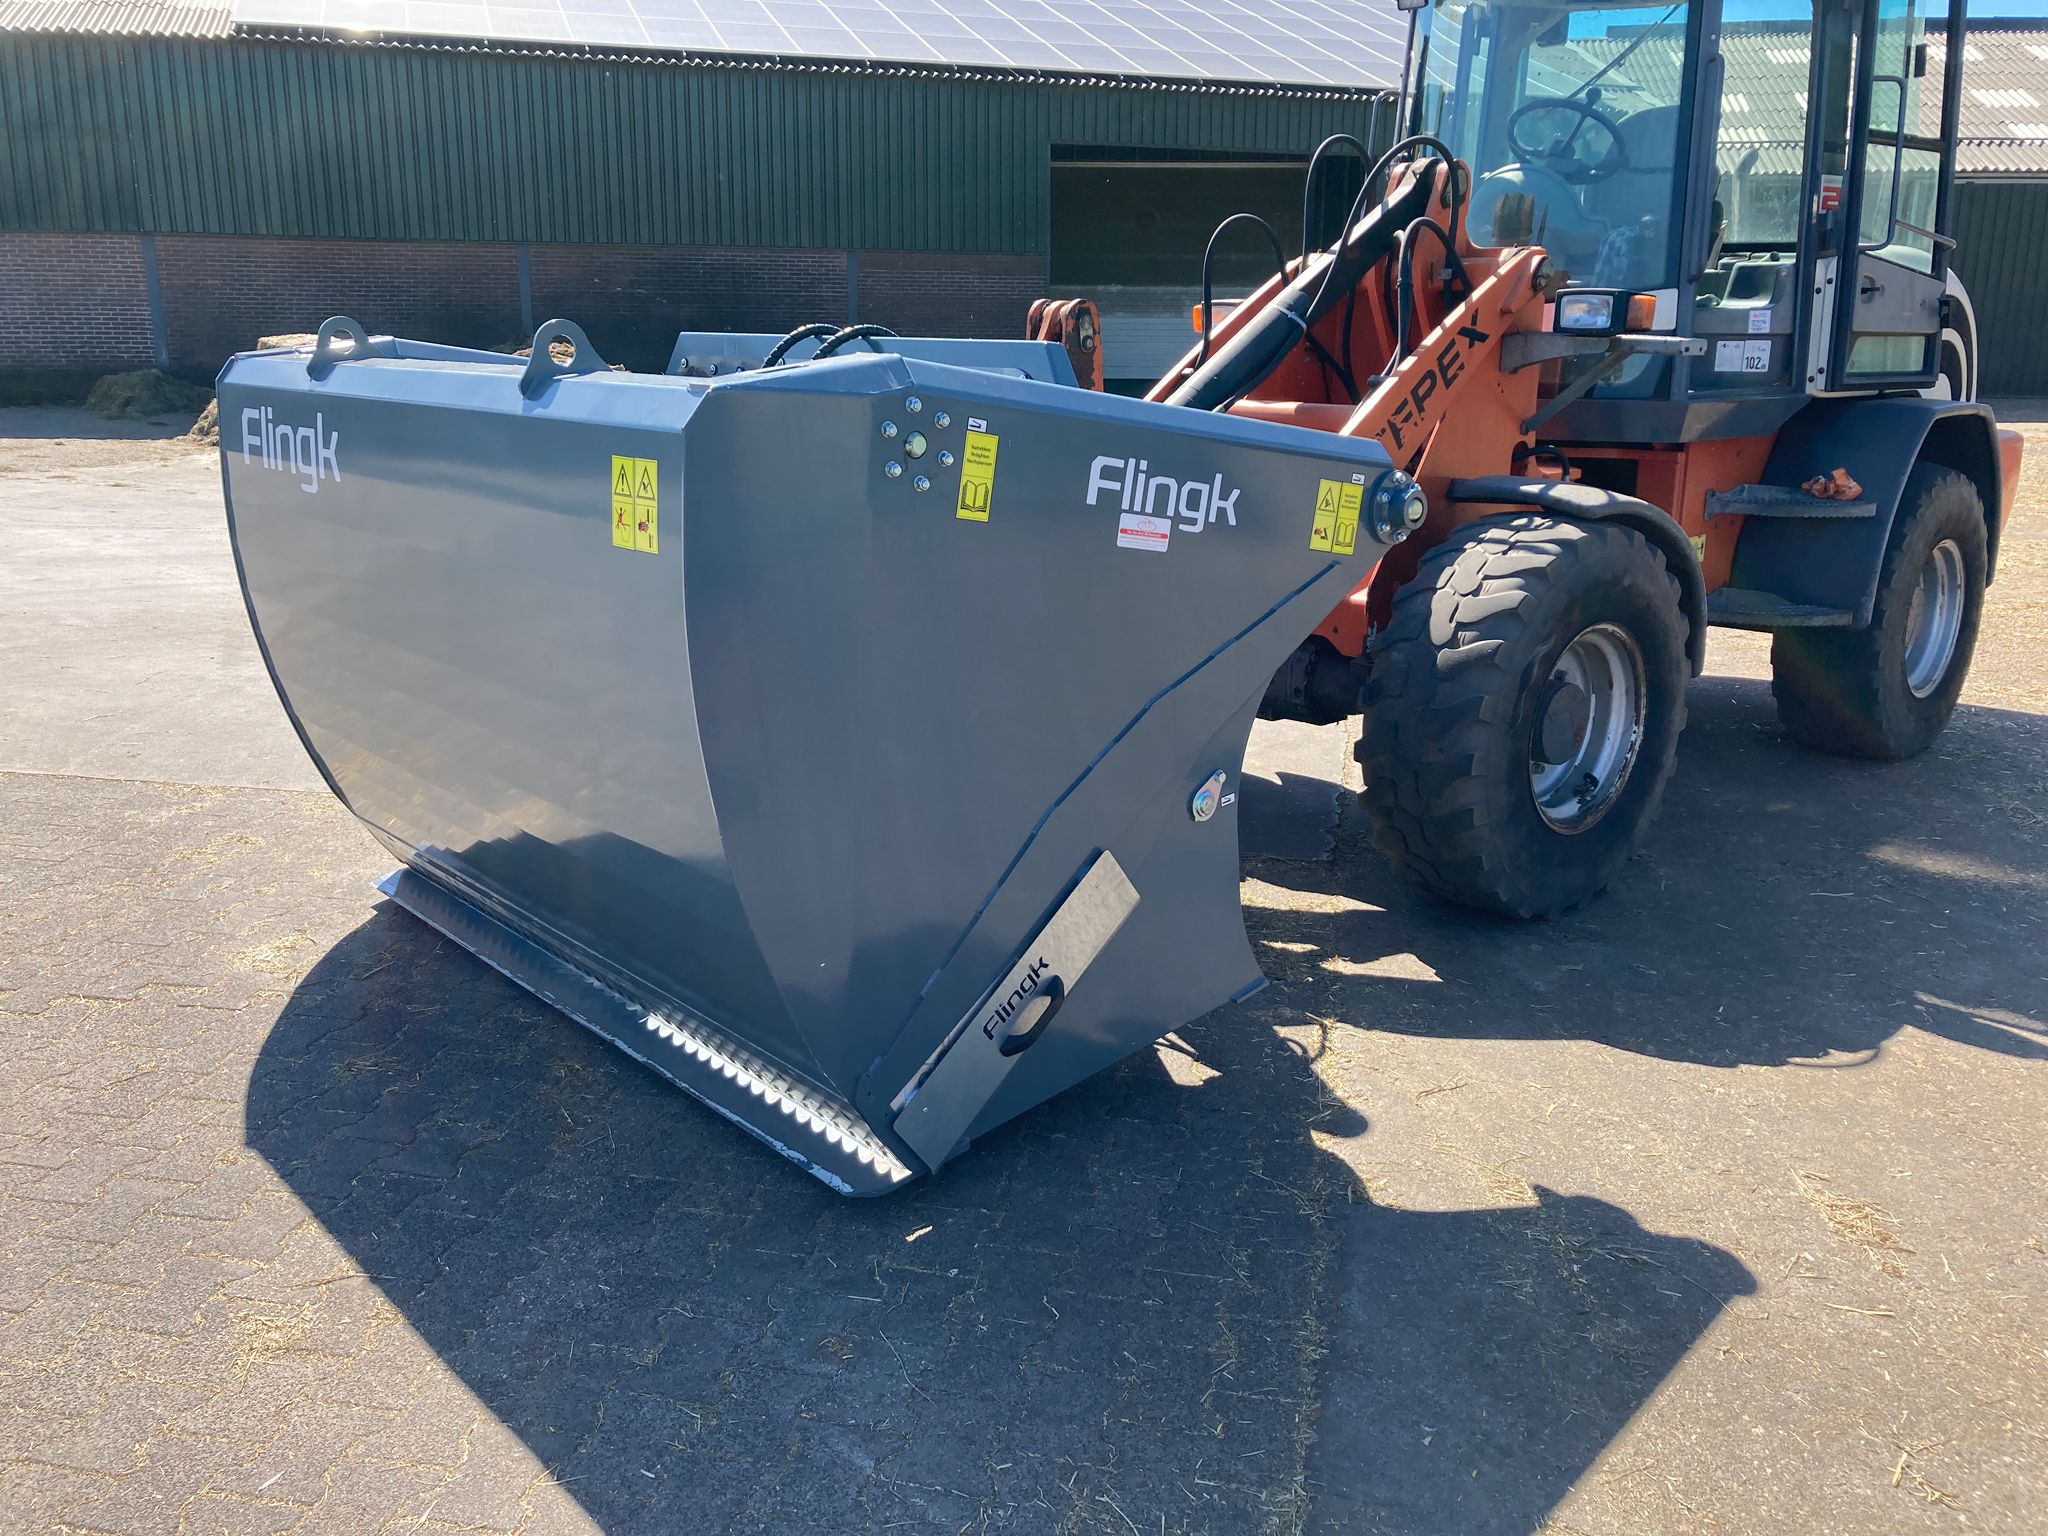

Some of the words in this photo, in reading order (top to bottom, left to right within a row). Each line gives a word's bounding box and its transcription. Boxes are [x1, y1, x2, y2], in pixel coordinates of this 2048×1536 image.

[1745, 357, 1761, 370] 102
[242, 405, 341, 493] Flingk
[1086, 455, 1241, 533] Flingk
[983, 956, 1049, 1041] Flingk
